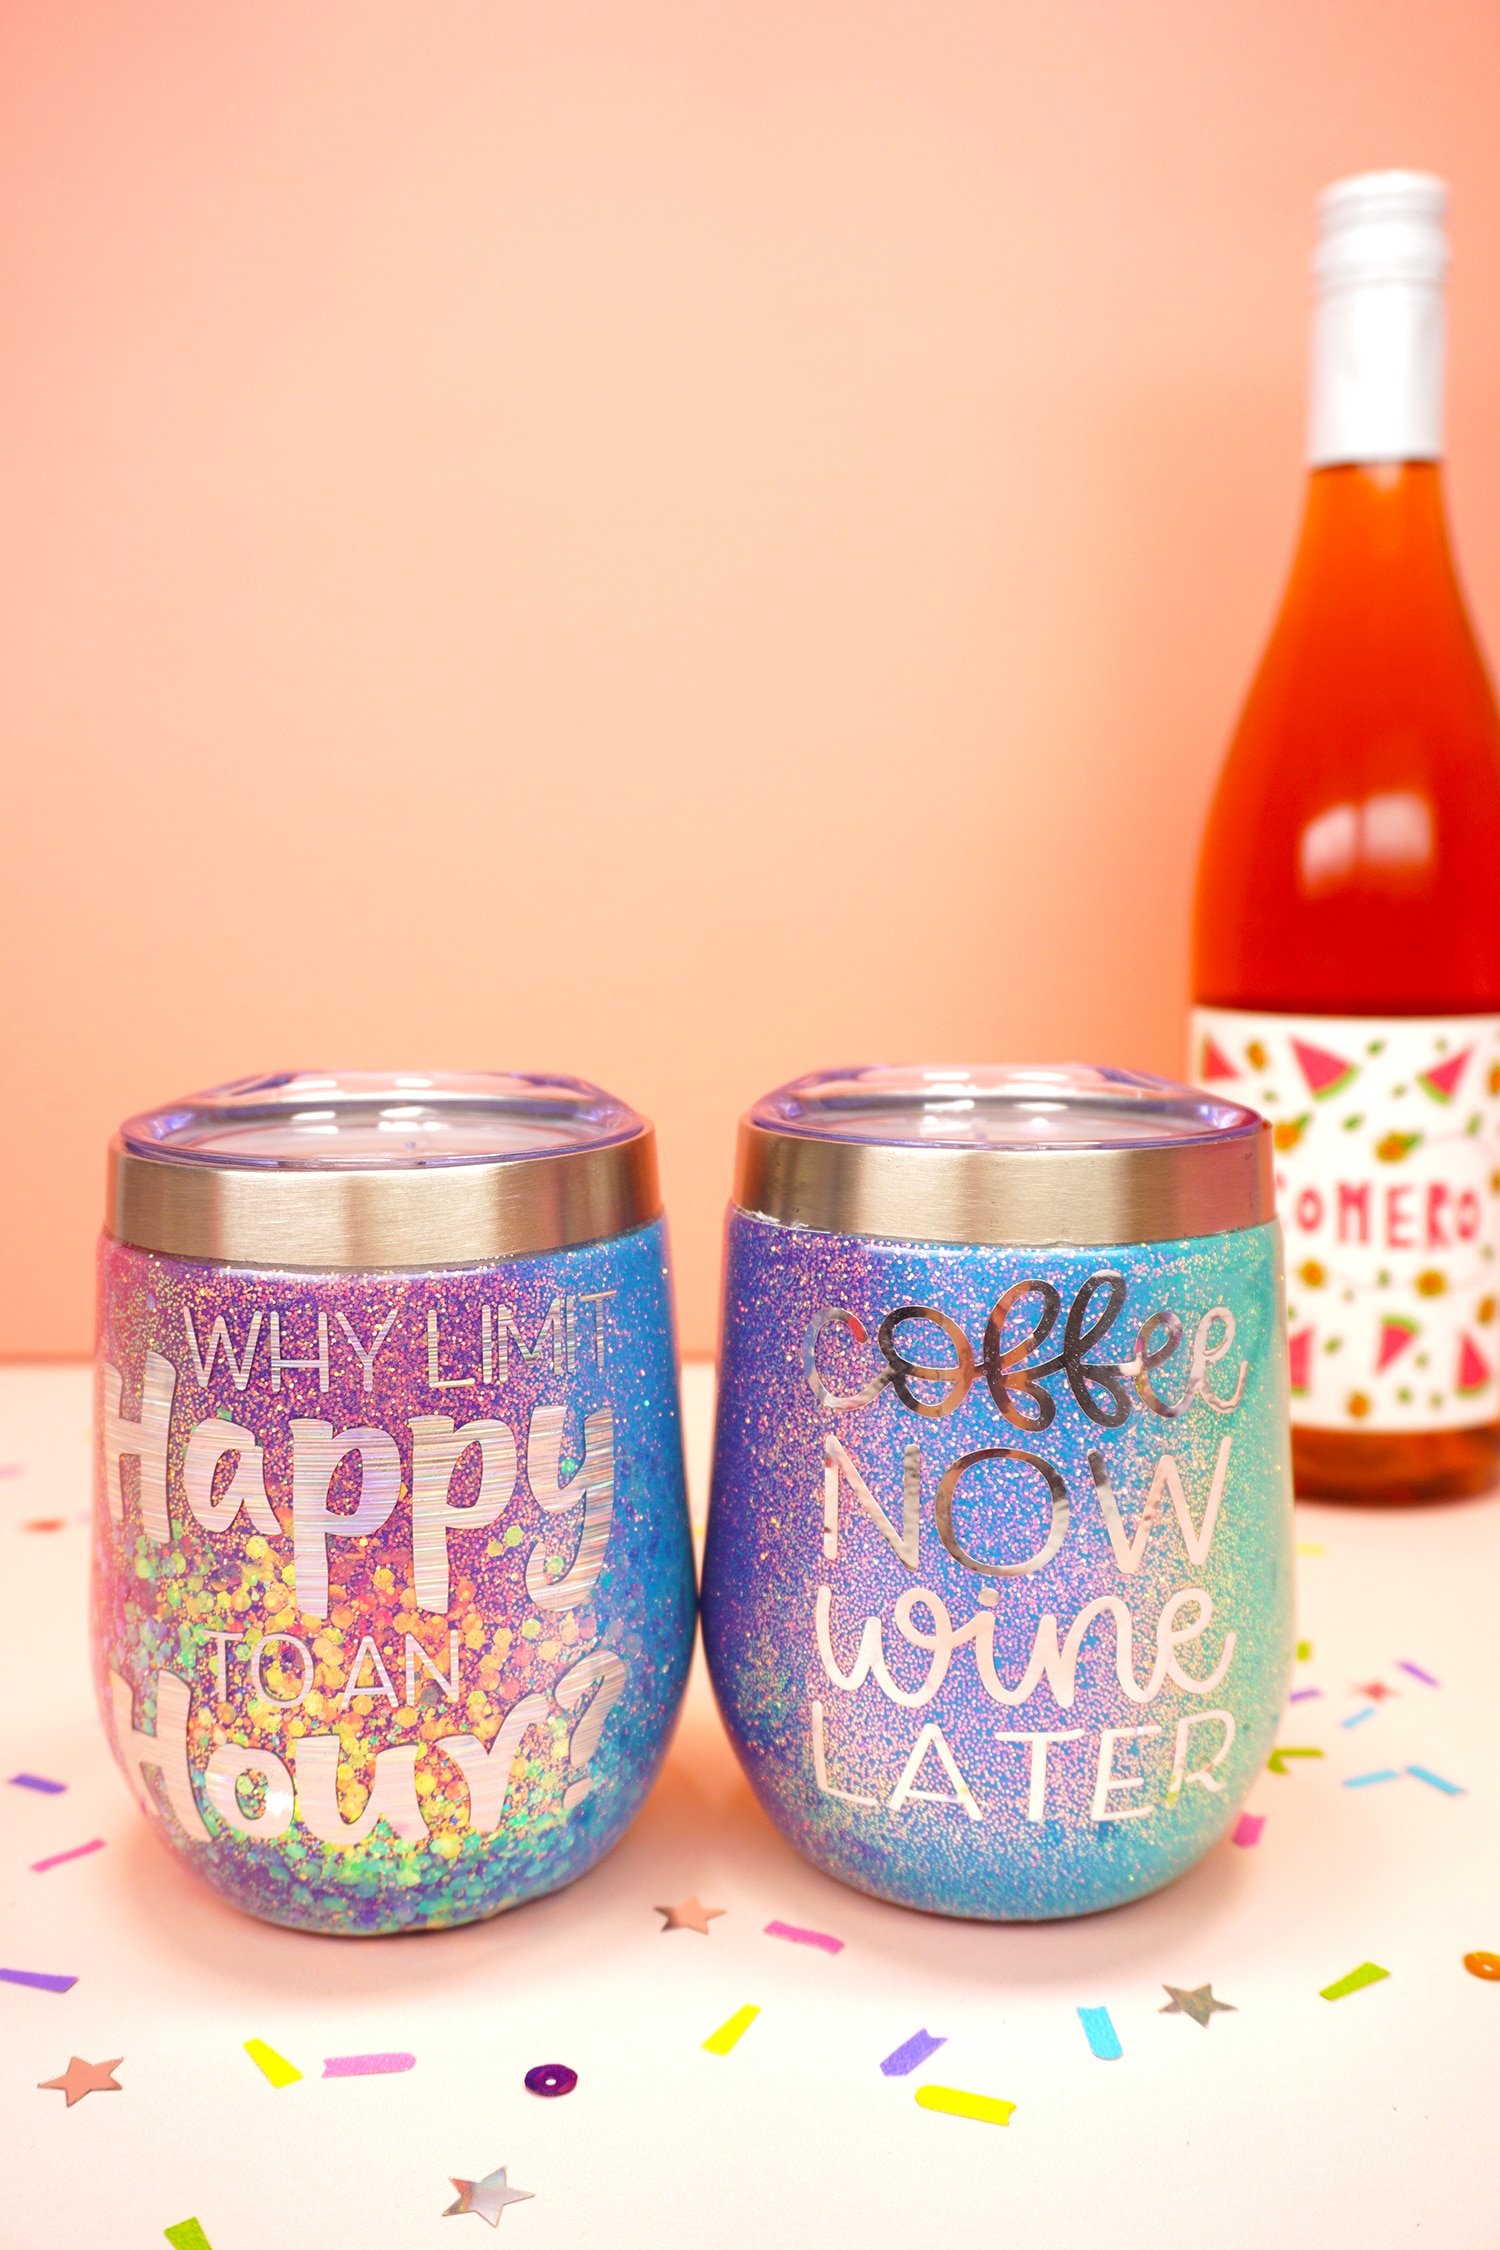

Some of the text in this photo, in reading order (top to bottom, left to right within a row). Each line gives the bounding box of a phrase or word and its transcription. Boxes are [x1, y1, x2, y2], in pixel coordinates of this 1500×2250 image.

[1276, 1173, 1480, 1250] OMERO
[183, 1290, 616, 1392] WHY LIMIT
[806, 1270, 1247, 1432] coffee
[104, 1351, 614, 1619] Happy
[823, 1435, 1232, 1577] NOW
[201, 1629, 460, 1708] TO AN
[816, 1585, 1235, 1708] wine
[110, 1650, 626, 1846] Hour?
[812, 1701, 1235, 1823] LATER
